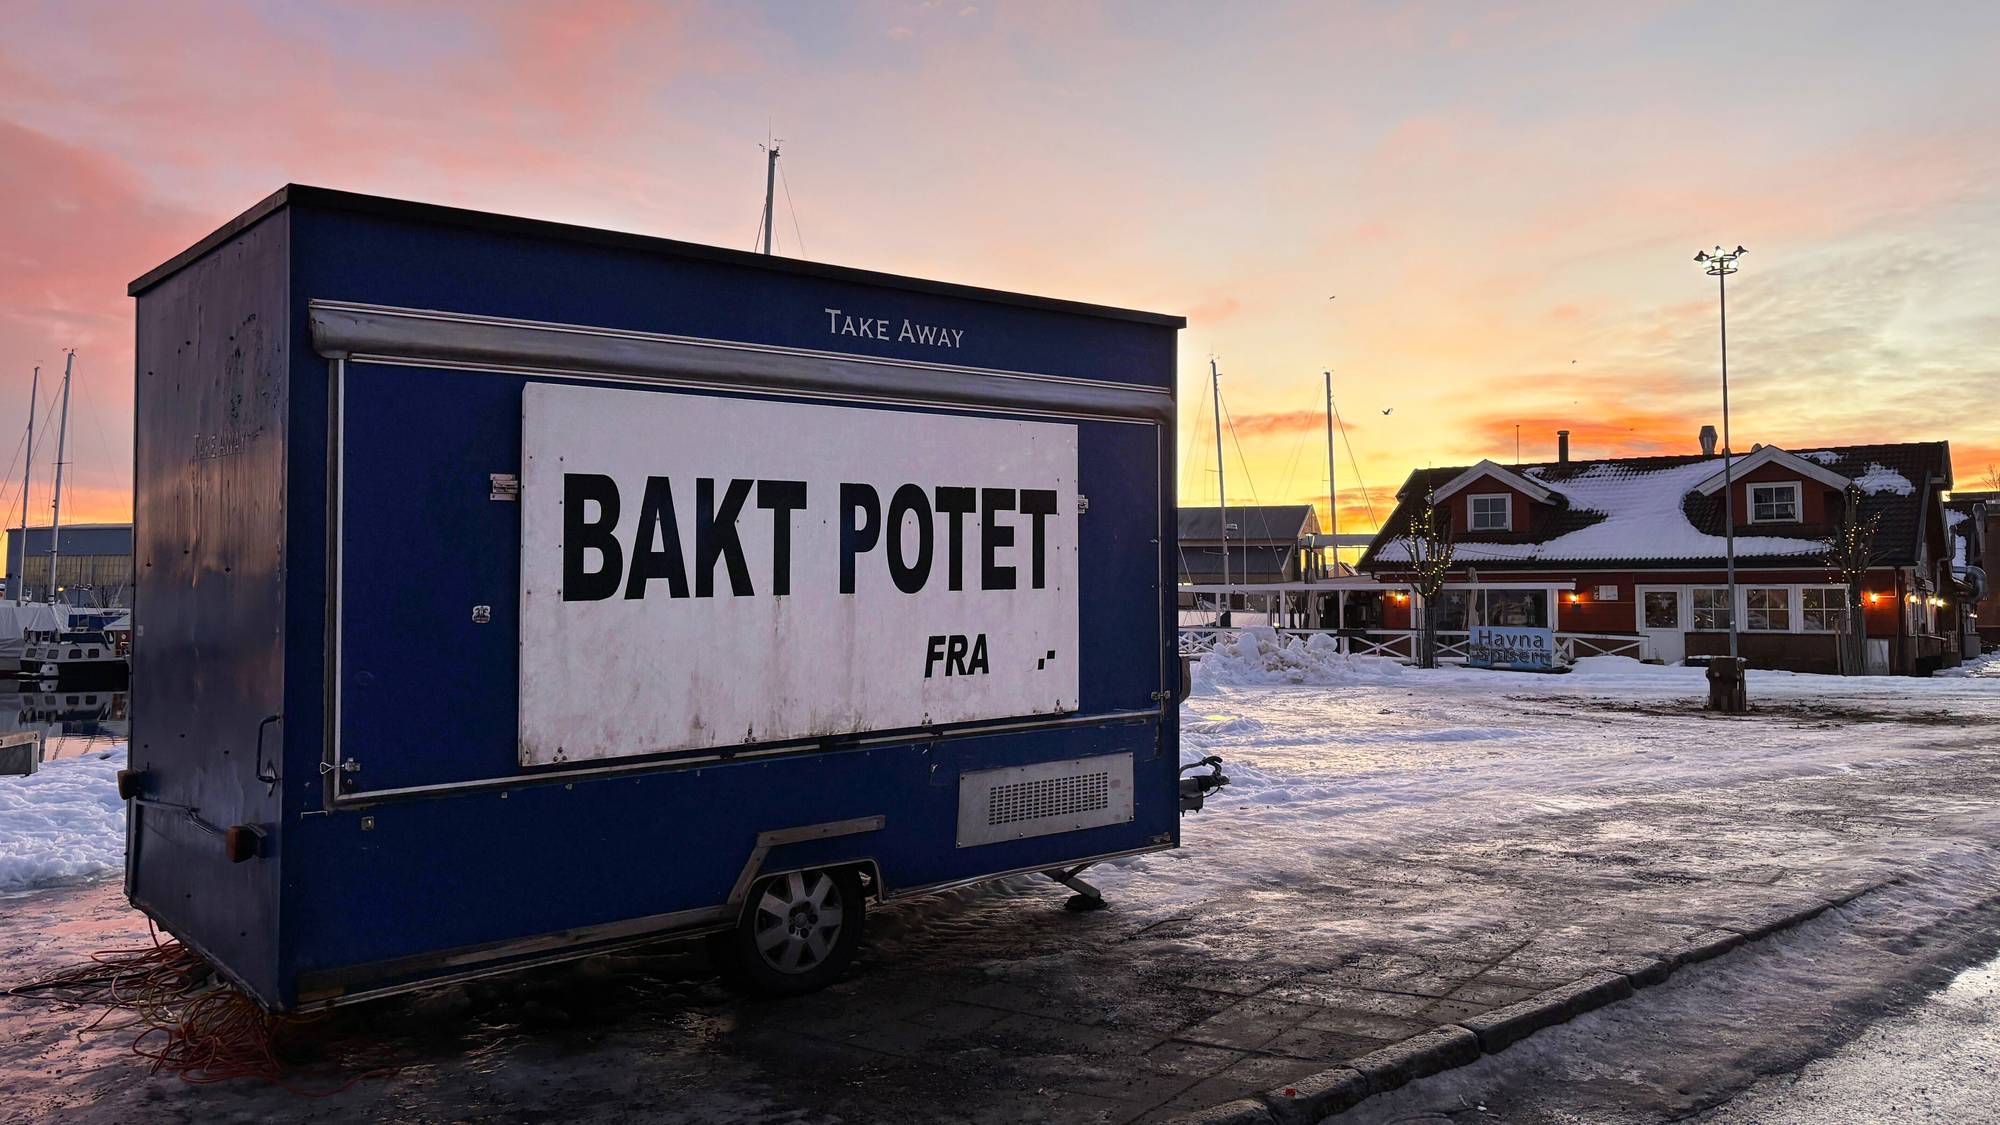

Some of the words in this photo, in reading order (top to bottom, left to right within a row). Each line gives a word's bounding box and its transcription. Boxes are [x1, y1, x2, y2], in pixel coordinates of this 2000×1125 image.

[563, 473, 808, 602] BAKT
[839, 483, 1058, 595] POTET
[924, 633, 990, 679] FRA
[1478, 630, 1544, 648] Havna
